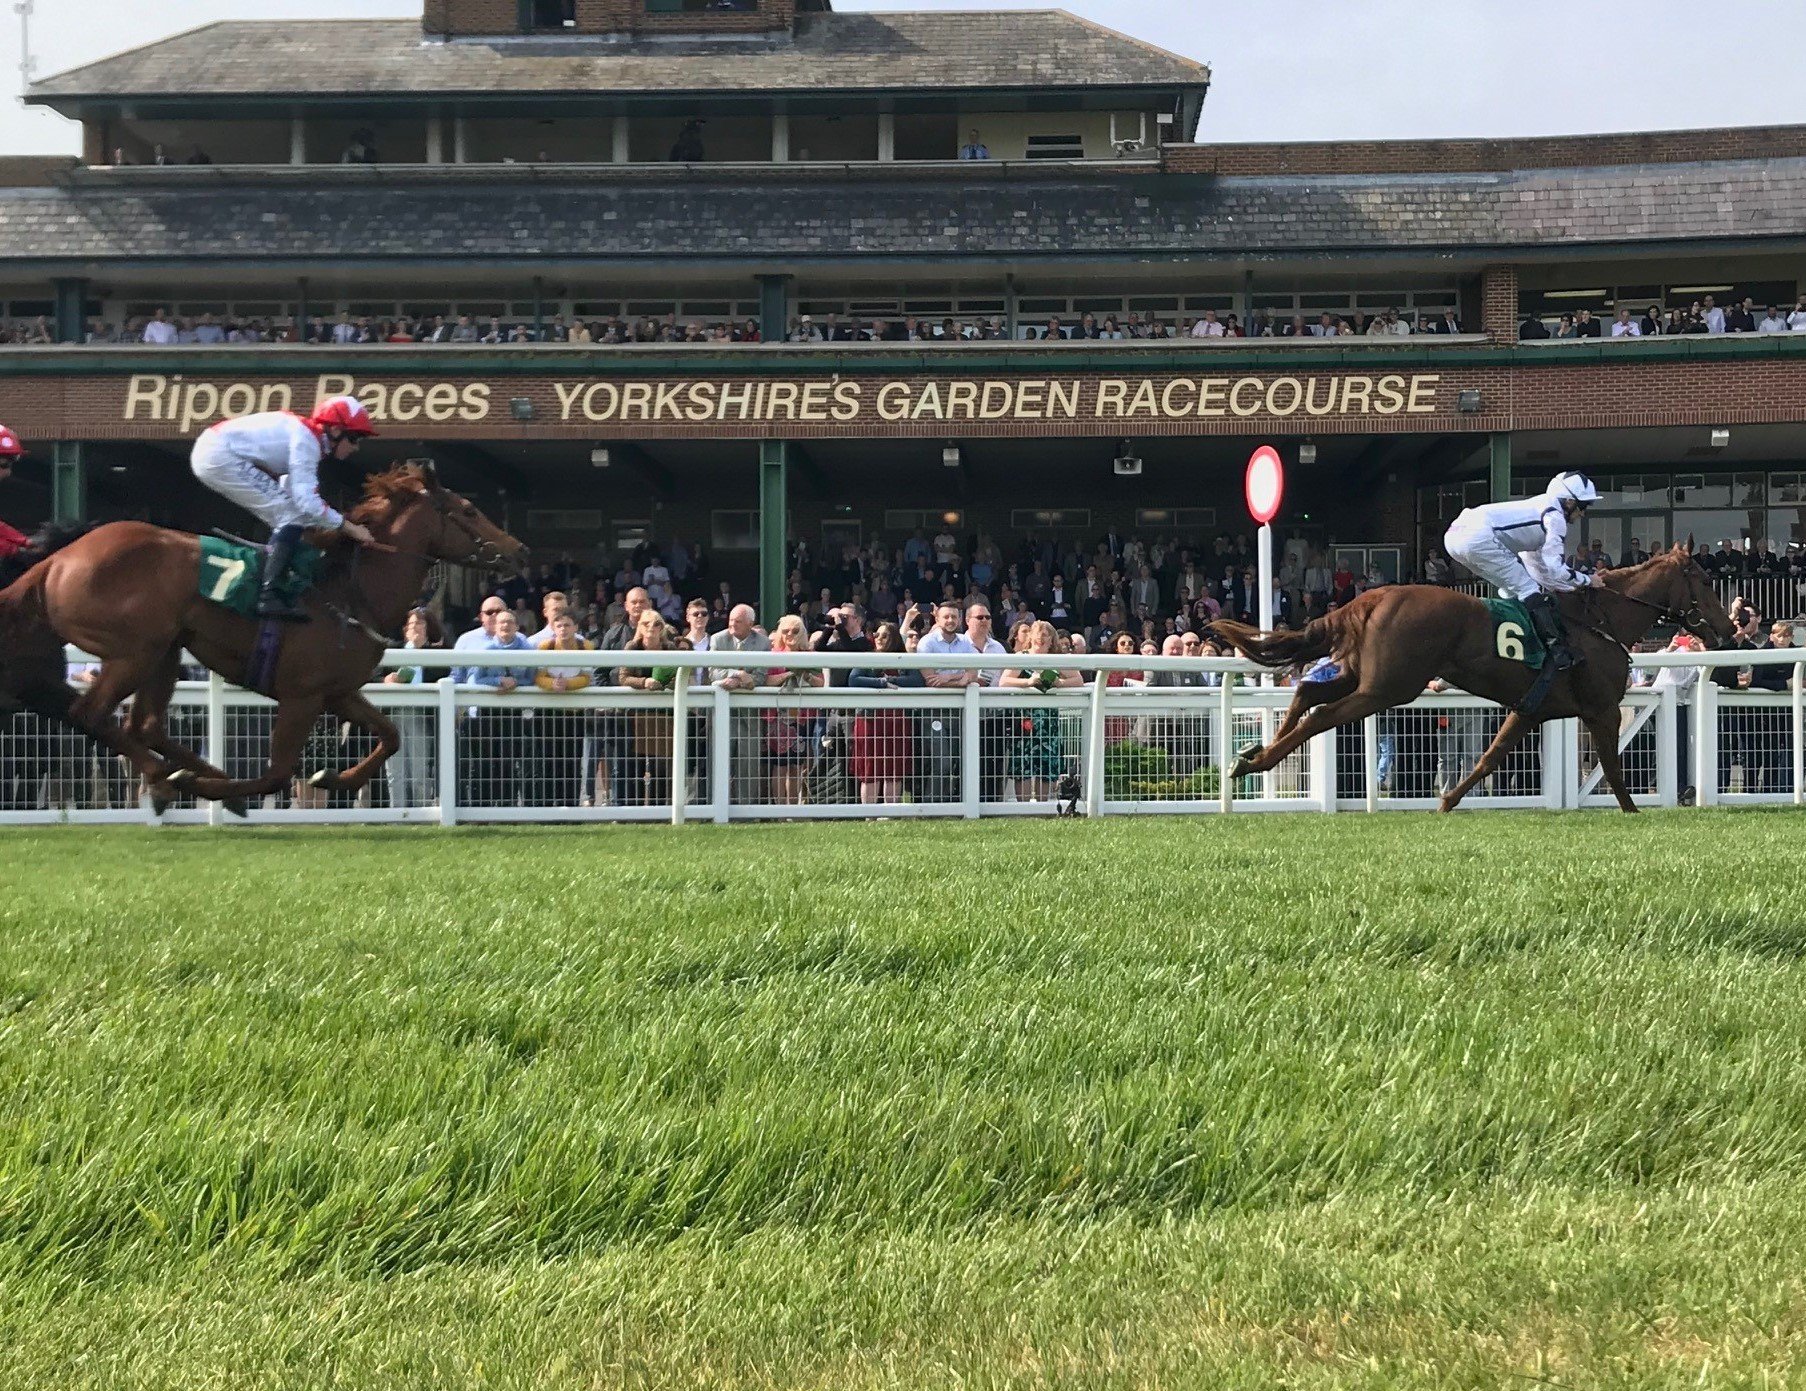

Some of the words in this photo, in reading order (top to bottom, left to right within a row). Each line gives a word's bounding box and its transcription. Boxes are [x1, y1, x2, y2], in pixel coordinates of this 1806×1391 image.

[124, 374, 292, 433] Ripon
[312, 373, 491, 421] Races
[553, 373, 861, 421] YORKSHIRE'S
[876, 380, 1081, 420] GARDEN
[1095, 374, 1440, 418] RACECOURSE
[207, 554, 245, 602] 7
[1496, 621, 1525, 661] 6
